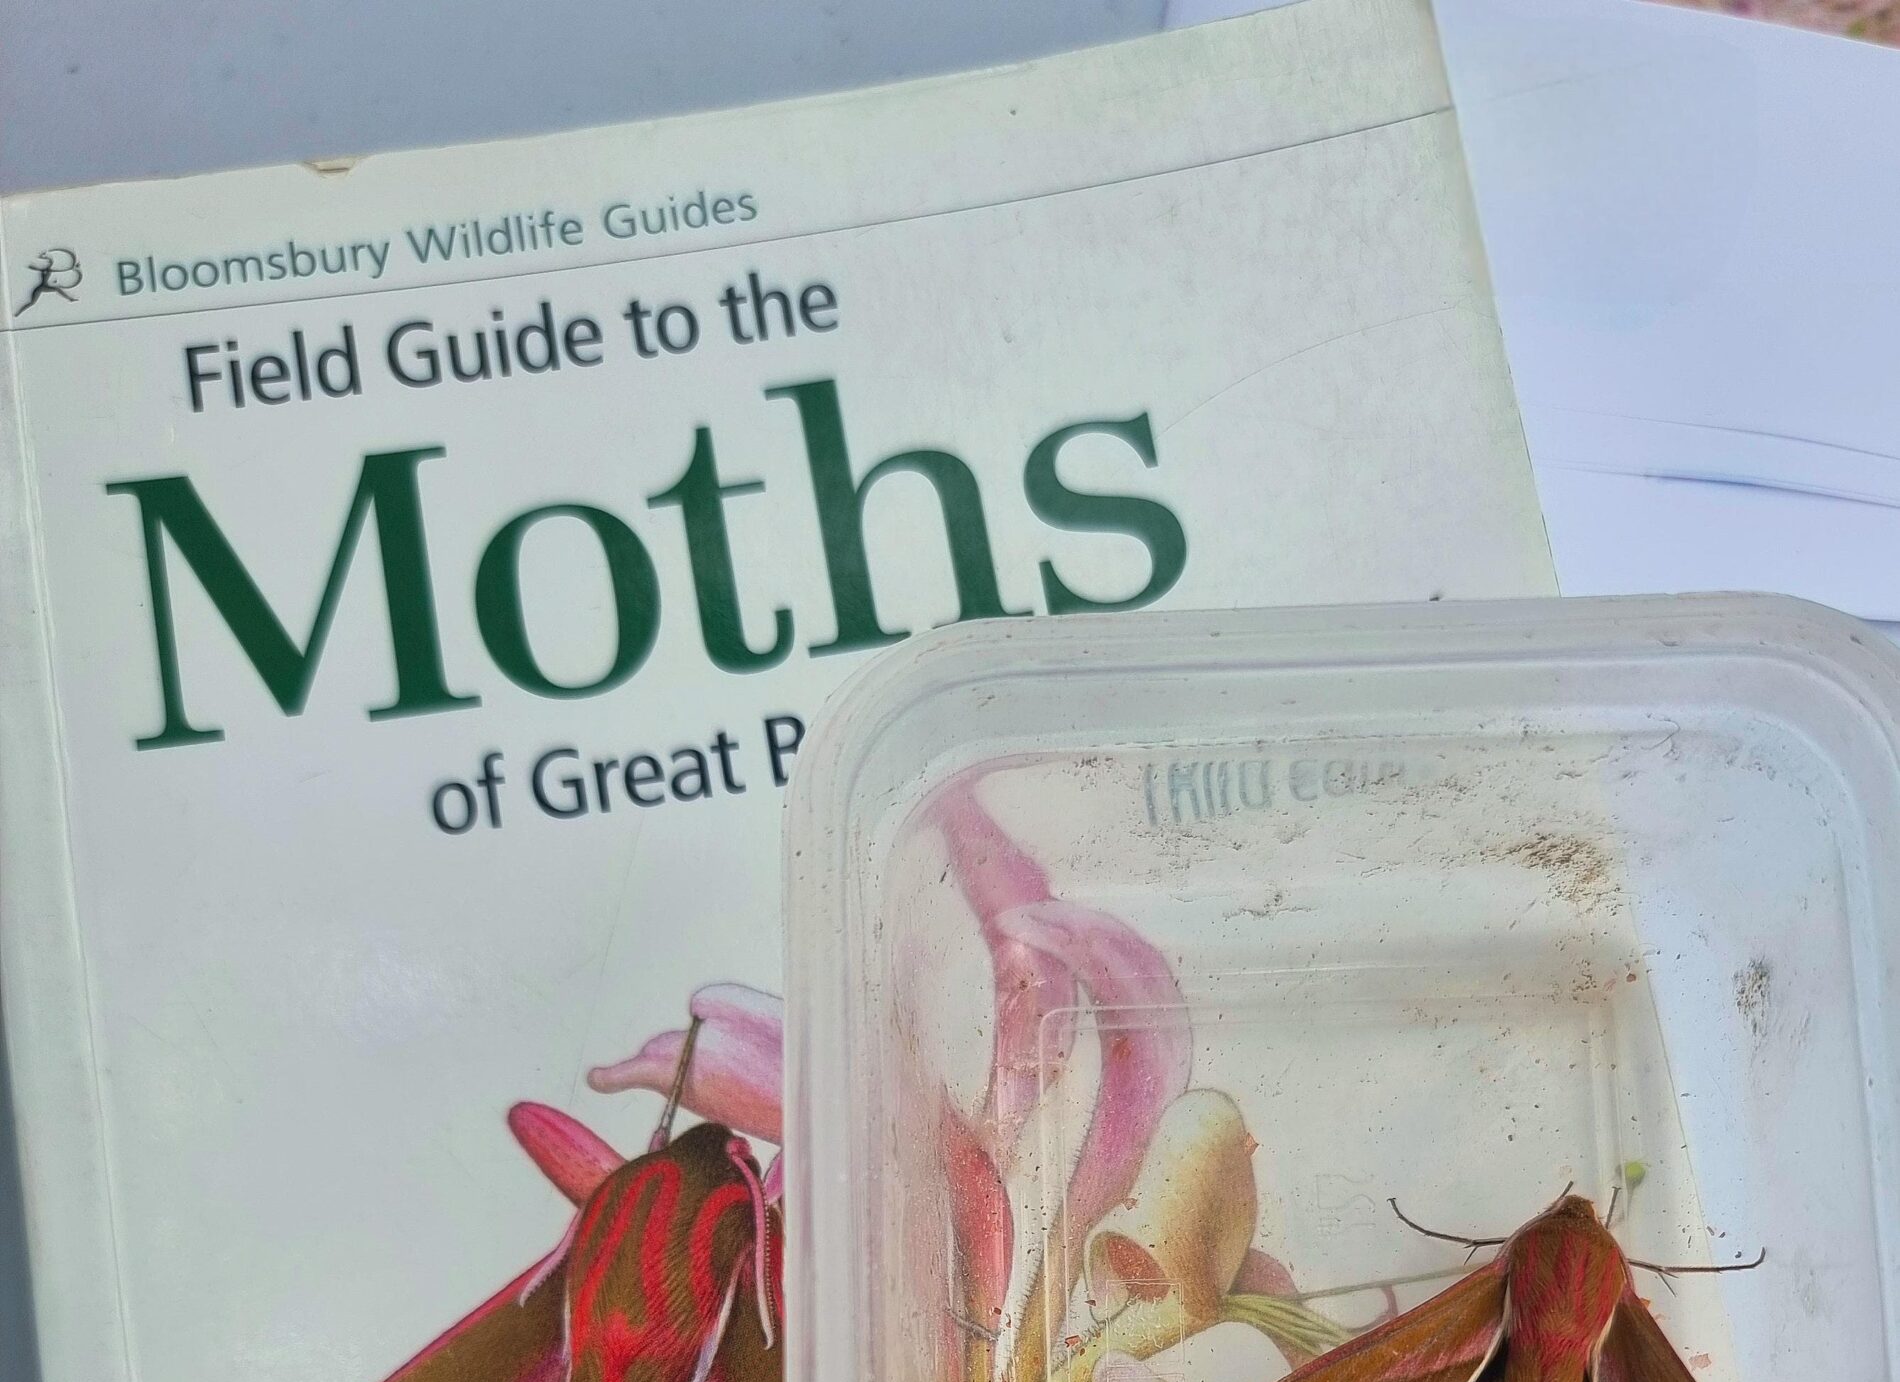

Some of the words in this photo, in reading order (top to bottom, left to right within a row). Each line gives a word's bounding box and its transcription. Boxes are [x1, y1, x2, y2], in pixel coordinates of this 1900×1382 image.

[116, 240, 390, 297] Bloomsbury
[405, 209, 584, 264] Wildlife
[602, 190, 758, 239] Guides
[184, 324, 362, 413] Field
[386, 300, 603, 388] Guide
[622, 299, 700, 359] to
[718, 271, 838, 345] the
[106, 379, 1188, 752] Moths
[431, 751, 505, 835] of
[530, 731, 746, 819] Great
